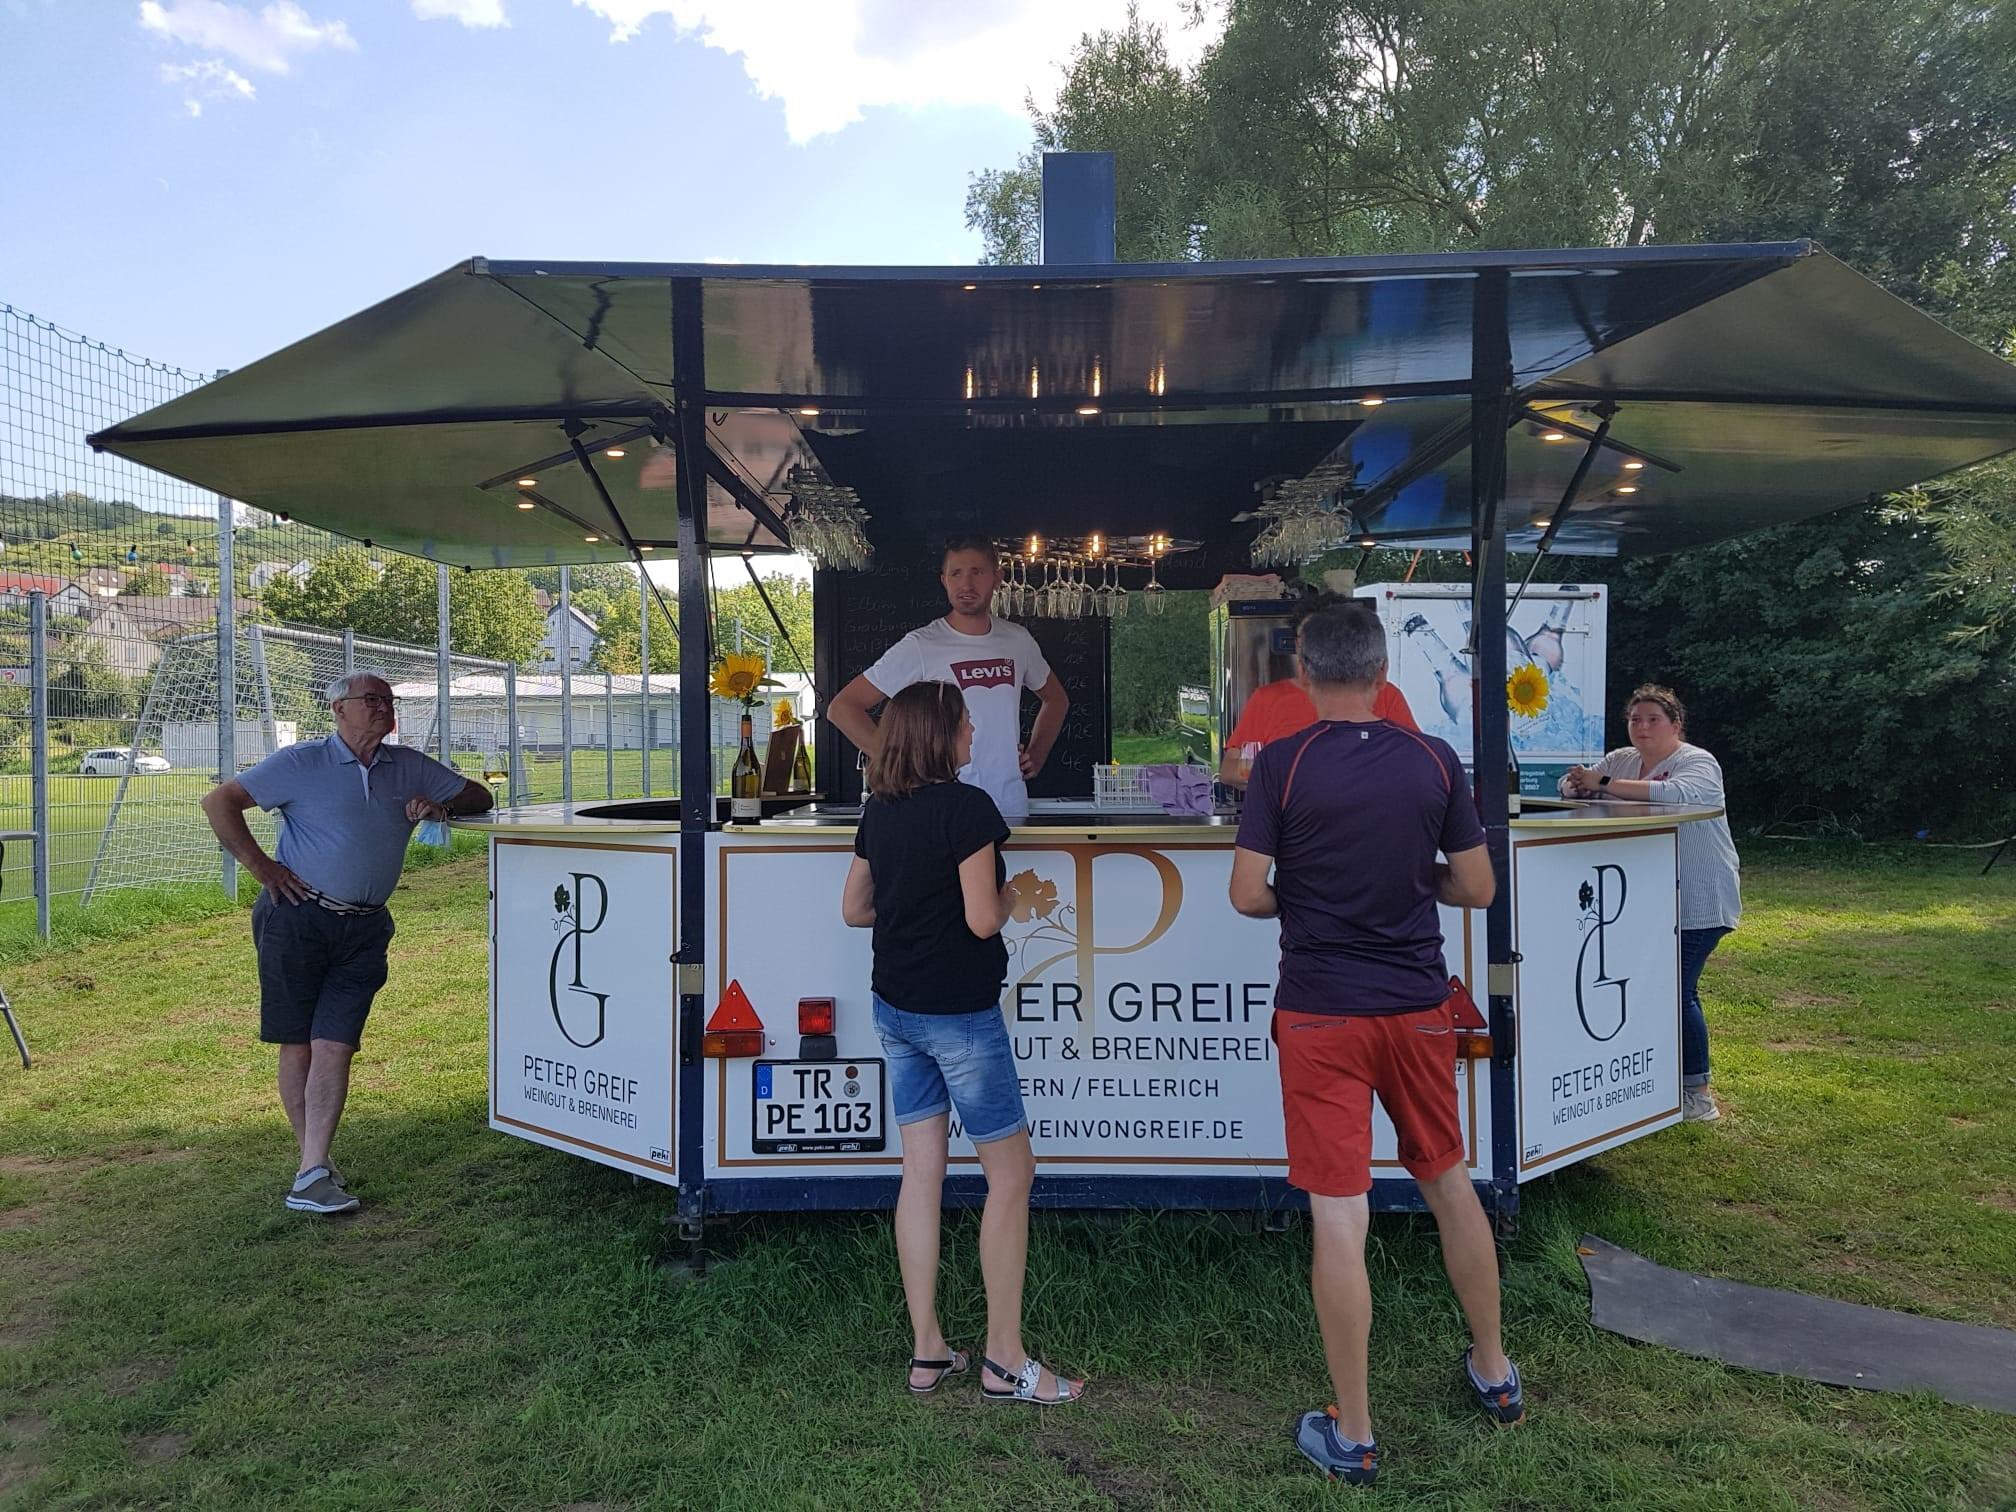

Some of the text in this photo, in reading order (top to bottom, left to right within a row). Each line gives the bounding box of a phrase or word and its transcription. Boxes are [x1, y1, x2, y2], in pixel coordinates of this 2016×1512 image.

[1108, 981, 1271, 1023] GREIF
[1061, 1036, 1080, 1060] &
[1092, 1037, 1270, 1061] BRENNEREI
[524, 1054, 638, 1105] PETER GREIF
[793, 1069, 832, 1099] TR
[1087, 1078, 1219, 1097] FELLERICH
[1552, 1048, 1654, 1102] PETER GREIF
[761, 1086, 768, 1095] D
[1552, 1079, 1655, 1126] WEINGUT & BRENNEREI
[524, 1084, 638, 1130] WEINGUT & BRENNEREI
[766, 1103, 871, 1134] PE 103
[650, 1148, 670, 1162] peki
[1525, 1145, 1542, 1161] peki
